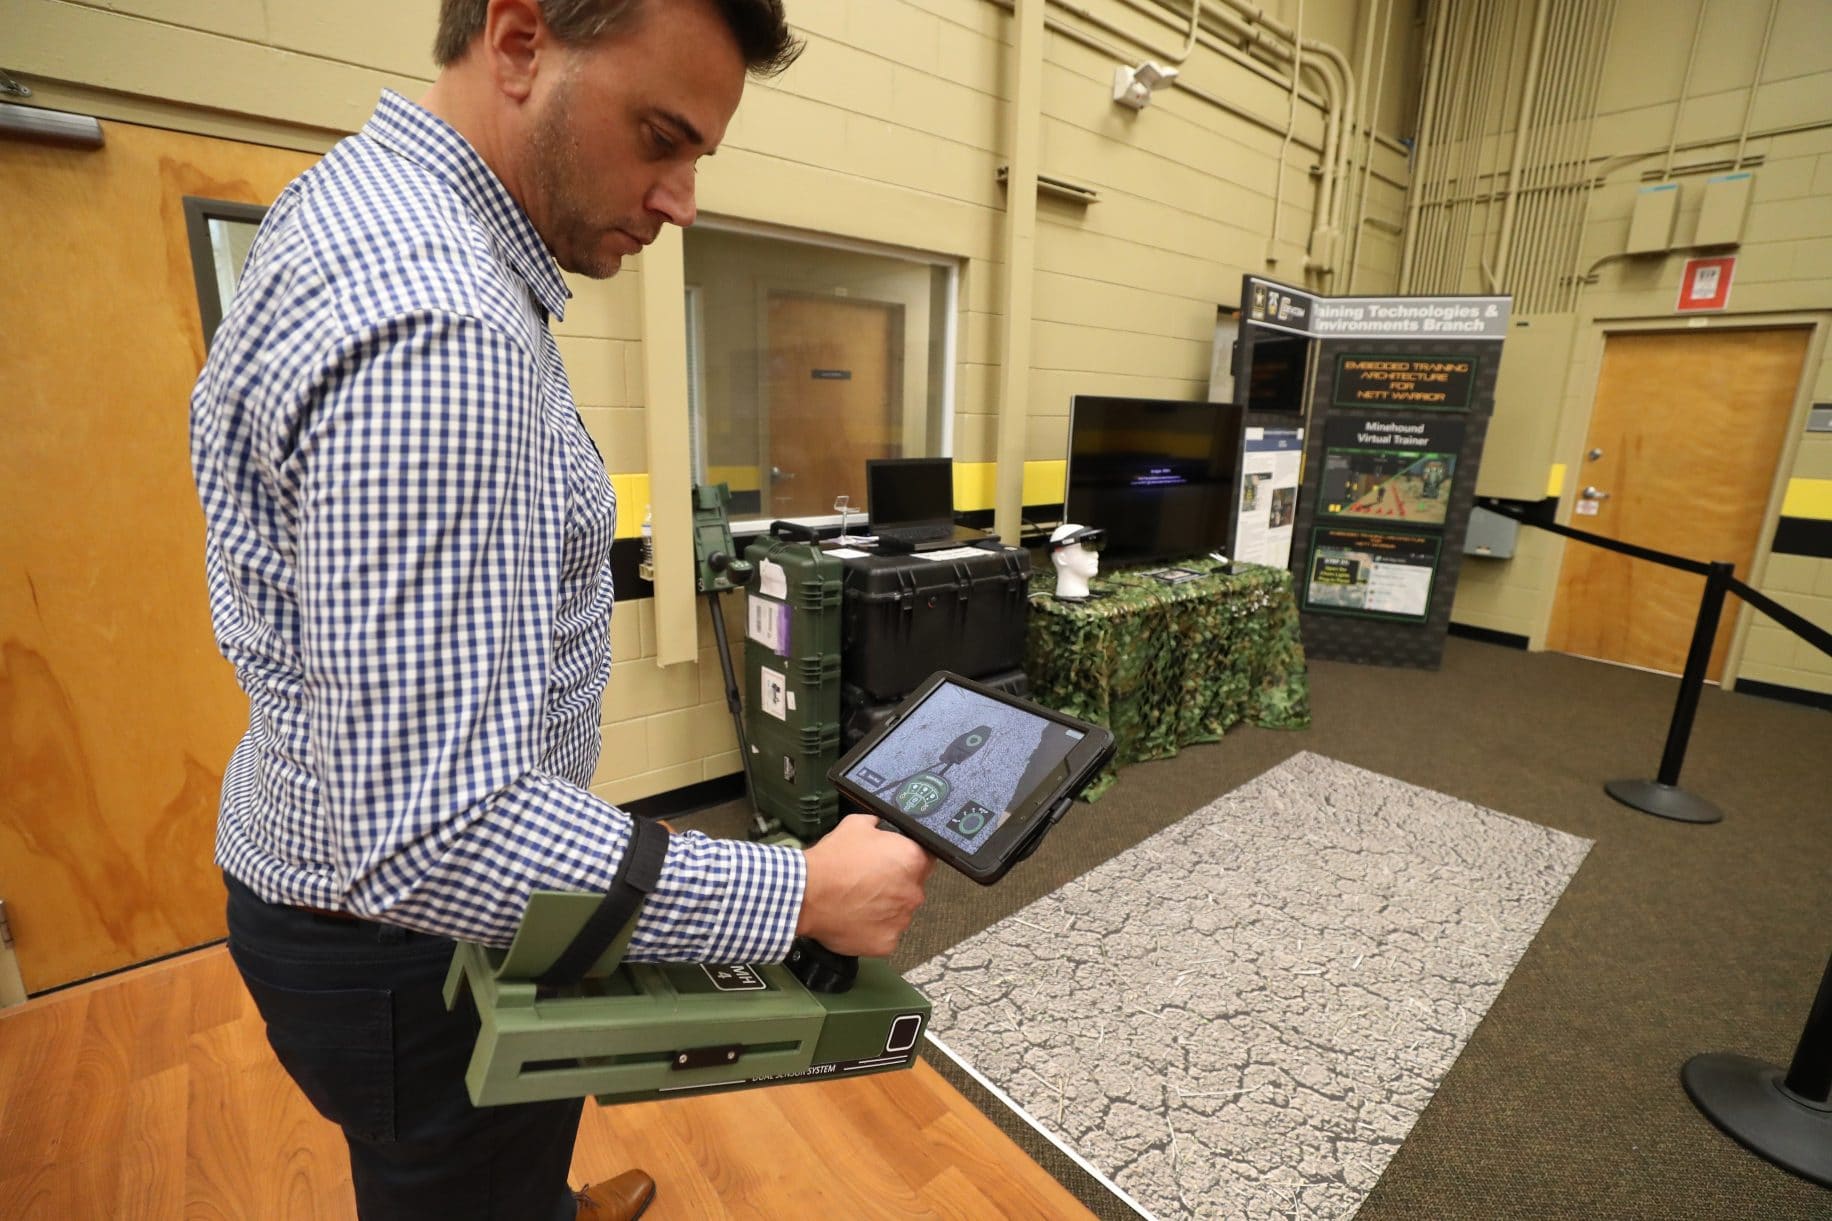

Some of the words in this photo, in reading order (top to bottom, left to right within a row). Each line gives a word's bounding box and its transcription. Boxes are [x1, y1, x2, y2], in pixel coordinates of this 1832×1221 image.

[1368, 304, 1480, 320] Technologies
[1485, 304, 1499, 318] &
[1423, 318, 1485, 332] Branch
[1344, 361, 1410, 371] EMBEDDED
[1412, 362, 1469, 373] TRAINING
[1360, 371, 1449, 382] ARCHITECTURE
[1389, 381, 1416, 390] FOR
[1357, 390, 1389, 399] NETT
[1391, 391, 1447, 402] WARRIOR
[1364, 421, 1425, 434] Minehound
[1357, 433, 1392, 444] Virtual
[1394, 434, 1430, 446] Trainer
[717, 971, 732, 979] 4
[730, 965, 757, 984] MH
[806, 1064, 836, 1075] SYSTEM
